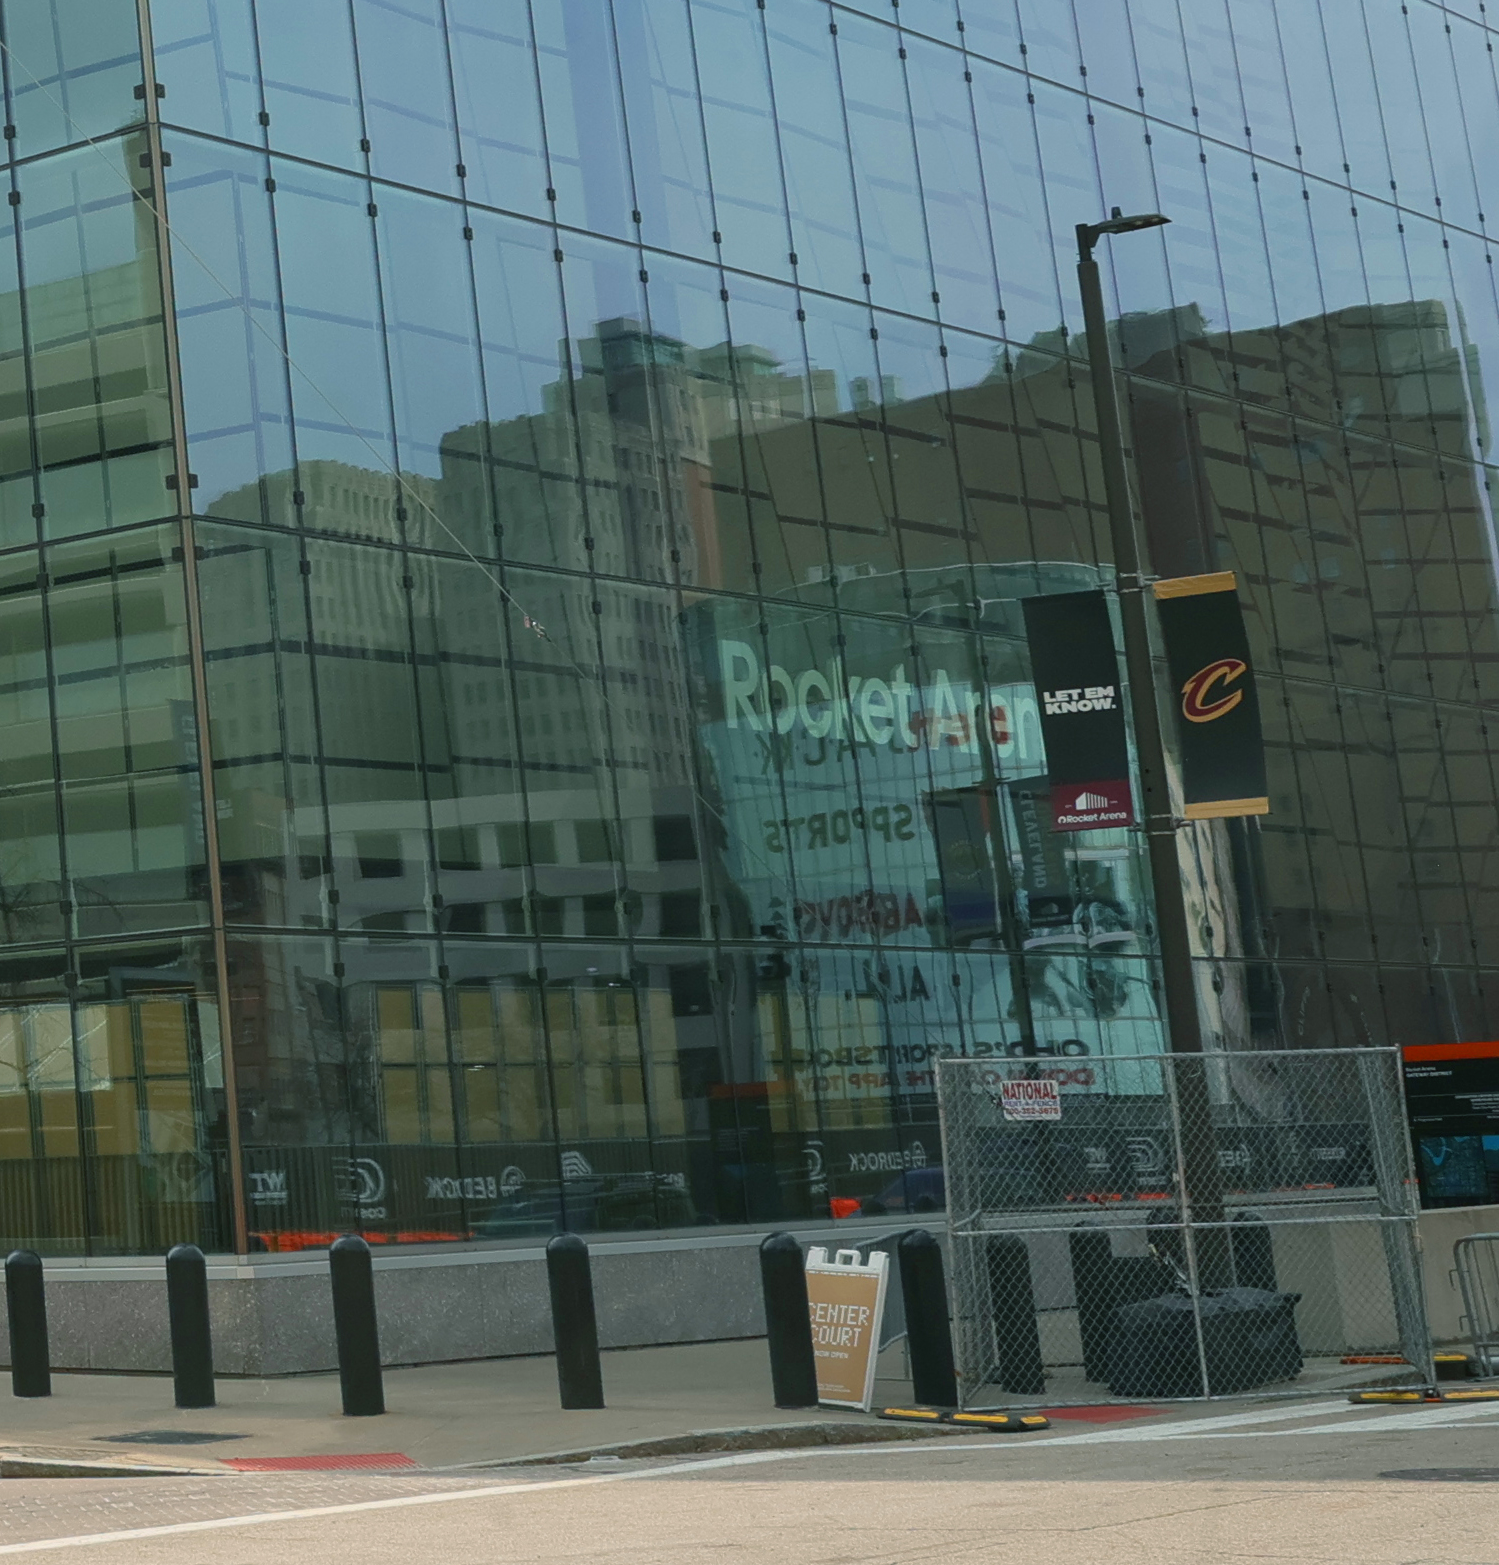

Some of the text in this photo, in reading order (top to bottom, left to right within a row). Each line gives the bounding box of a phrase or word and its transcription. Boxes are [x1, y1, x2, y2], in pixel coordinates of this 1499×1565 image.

[1043, 686, 1115, 703] LET EM
[926, 667, 1048, 761] Aren
[1045, 698, 1117, 716] KNOW.
[1066, 811, 1127, 824] Rocket Arena
[1002, 1081, 1058, 1100] NATIONAL
[808, 1302, 870, 1326] CENTER
[810, 1324, 862, 1347] COURT
